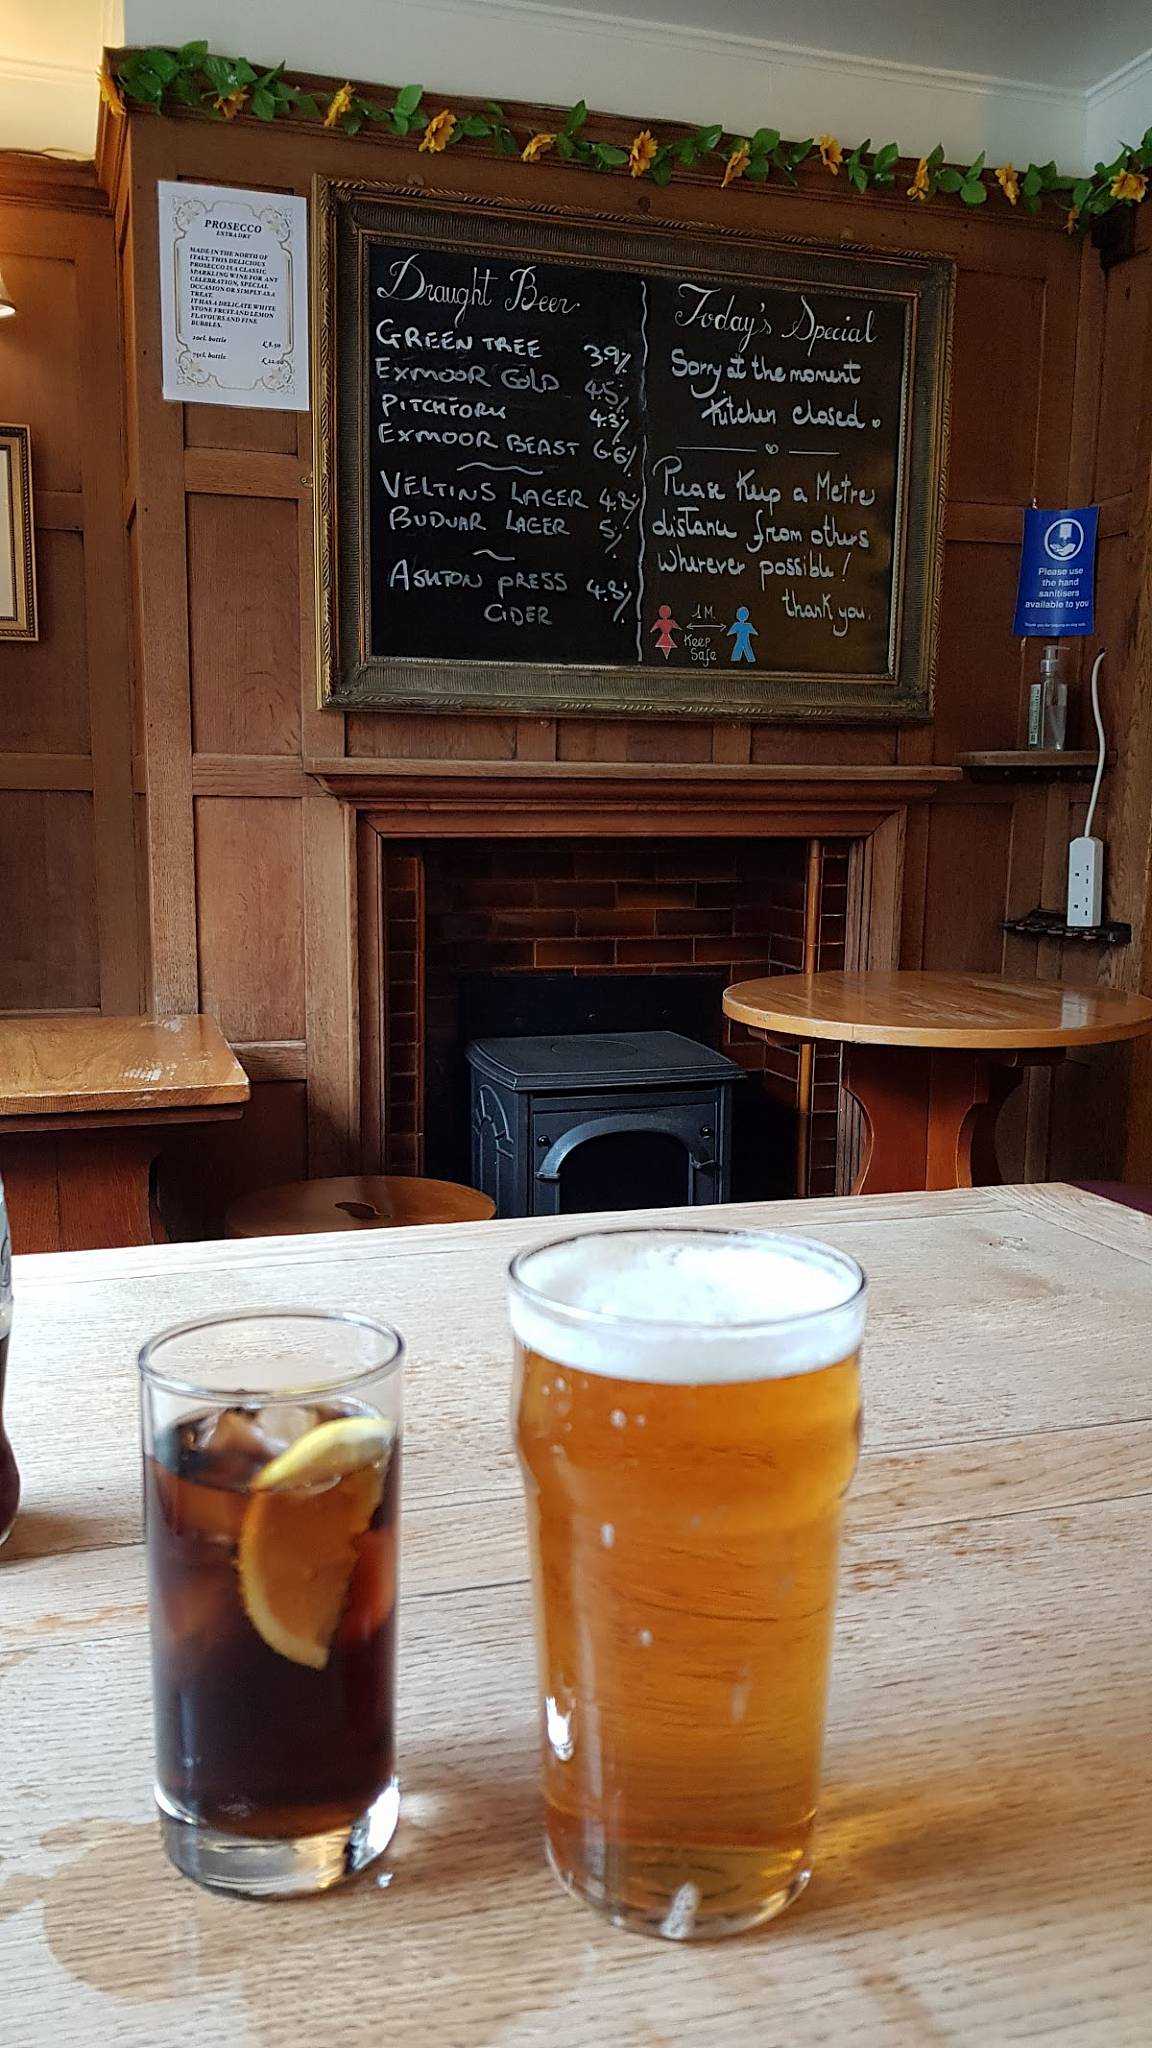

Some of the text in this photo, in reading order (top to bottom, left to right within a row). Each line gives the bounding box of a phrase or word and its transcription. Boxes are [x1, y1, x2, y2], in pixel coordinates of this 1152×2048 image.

[204, 219, 262, 233] PROSECCO
[190, 246, 209, 254] MADE
[234, 251, 258, 259] NORTH
[190, 261, 225, 270] PROSECCO
[239, 267, 267, 275] CLASSIC
[229, 258, 266, 267] DELICIOUS
[190, 269, 229, 278] SPARKLING
[377, 253, 498, 328] Draught
[191, 305, 212, 313] STONE
[218, 301, 253, 309] DELICATE
[191, 313, 226, 321] FLAVOURS
[674, 283, 878, 357] Today's Special
[208, 335, 227, 343] bottle
[376, 319, 473, 351] GREEN
[482, 337, 542, 358] TREE
[208, 352, 227, 360] bottle
[375, 357, 491, 387] EXMOOR
[671, 348, 862, 399] Sorry at the moment
[382, 394, 506, 419] PITCHFORK
[378, 422, 498, 449] EXMOOR
[506, 433, 580, 456] BEAST
[380, 470, 497, 501] VELTINS
[511, 482, 589, 509] LAGER
[652, 456, 875, 516] Please Keep a Metre
[389, 506, 487, 531] BUDVAR
[506, 510, 571, 535] LAGER
[652, 506, 870, 552] distance from others
[390, 559, 483, 591] ASHTON
[1038, 567, 1084, 576] Please use
[1042, 577, 1080, 587] the hand
[1038, 589, 1080, 598] sanitisers
[782, 588, 833, 620] thank
[1024, 600, 1063, 609] available
[1075, 600, 1089, 610] you
[484, 604, 552, 625] CIDER
[683, 633, 711, 648] Keep
[690, 648, 717, 667] Safe
